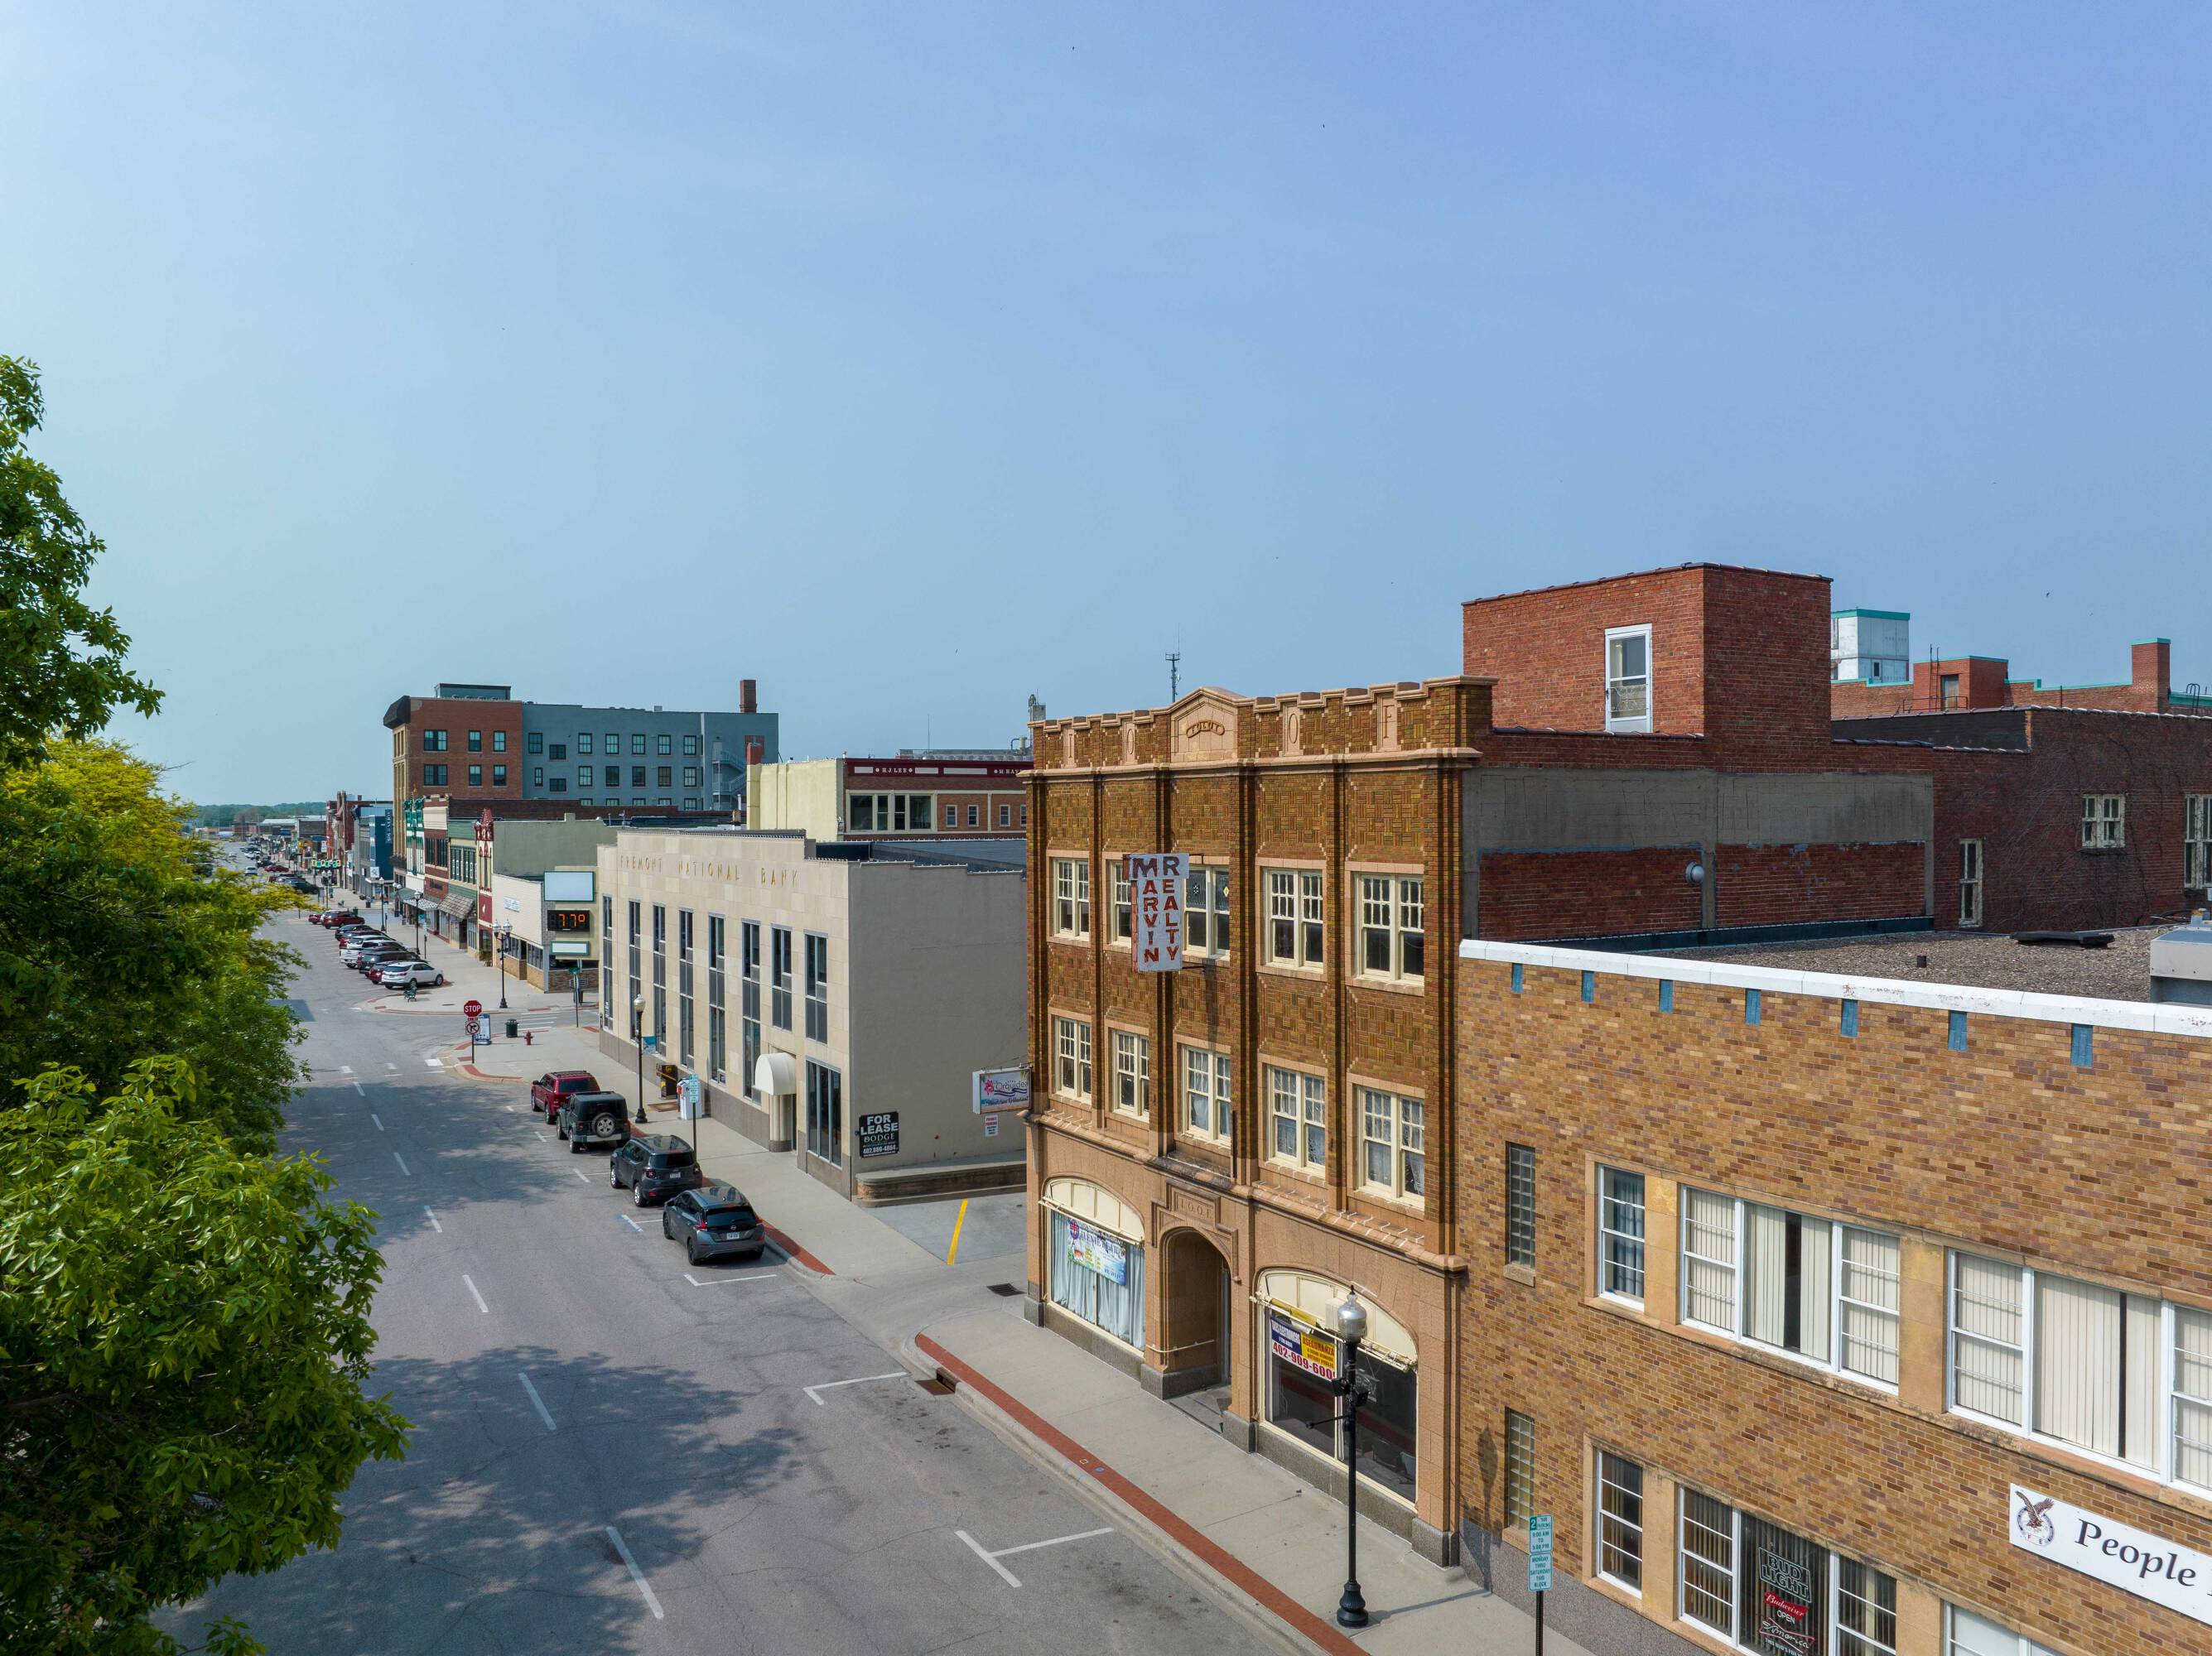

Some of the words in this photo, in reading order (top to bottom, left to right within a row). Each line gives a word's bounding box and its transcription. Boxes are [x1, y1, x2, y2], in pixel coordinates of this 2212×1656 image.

[620, 855, 663, 873] FREMONT
[678, 861, 740, 881] NATIONAL
[761, 867, 798, 887] BANK
[1132, 858, 1159, 963] MARVIN
[1163, 856, 1180, 960] REALTY
[860, 1122, 899, 1135] LEASE
[867, 1114, 891, 1125] FOR
[864, 1133, 894, 1143] DODGE
[1530, 1519, 1536, 1528] 2
[2075, 1518, 2196, 1586] People
[1768, 1555, 1801, 1581] BUD
[1761, 1565, 1809, 1597] LIGHT
[1766, 1593, 1805, 1616] Budweiser
[1776, 1610, 1795, 1624] OPEN
